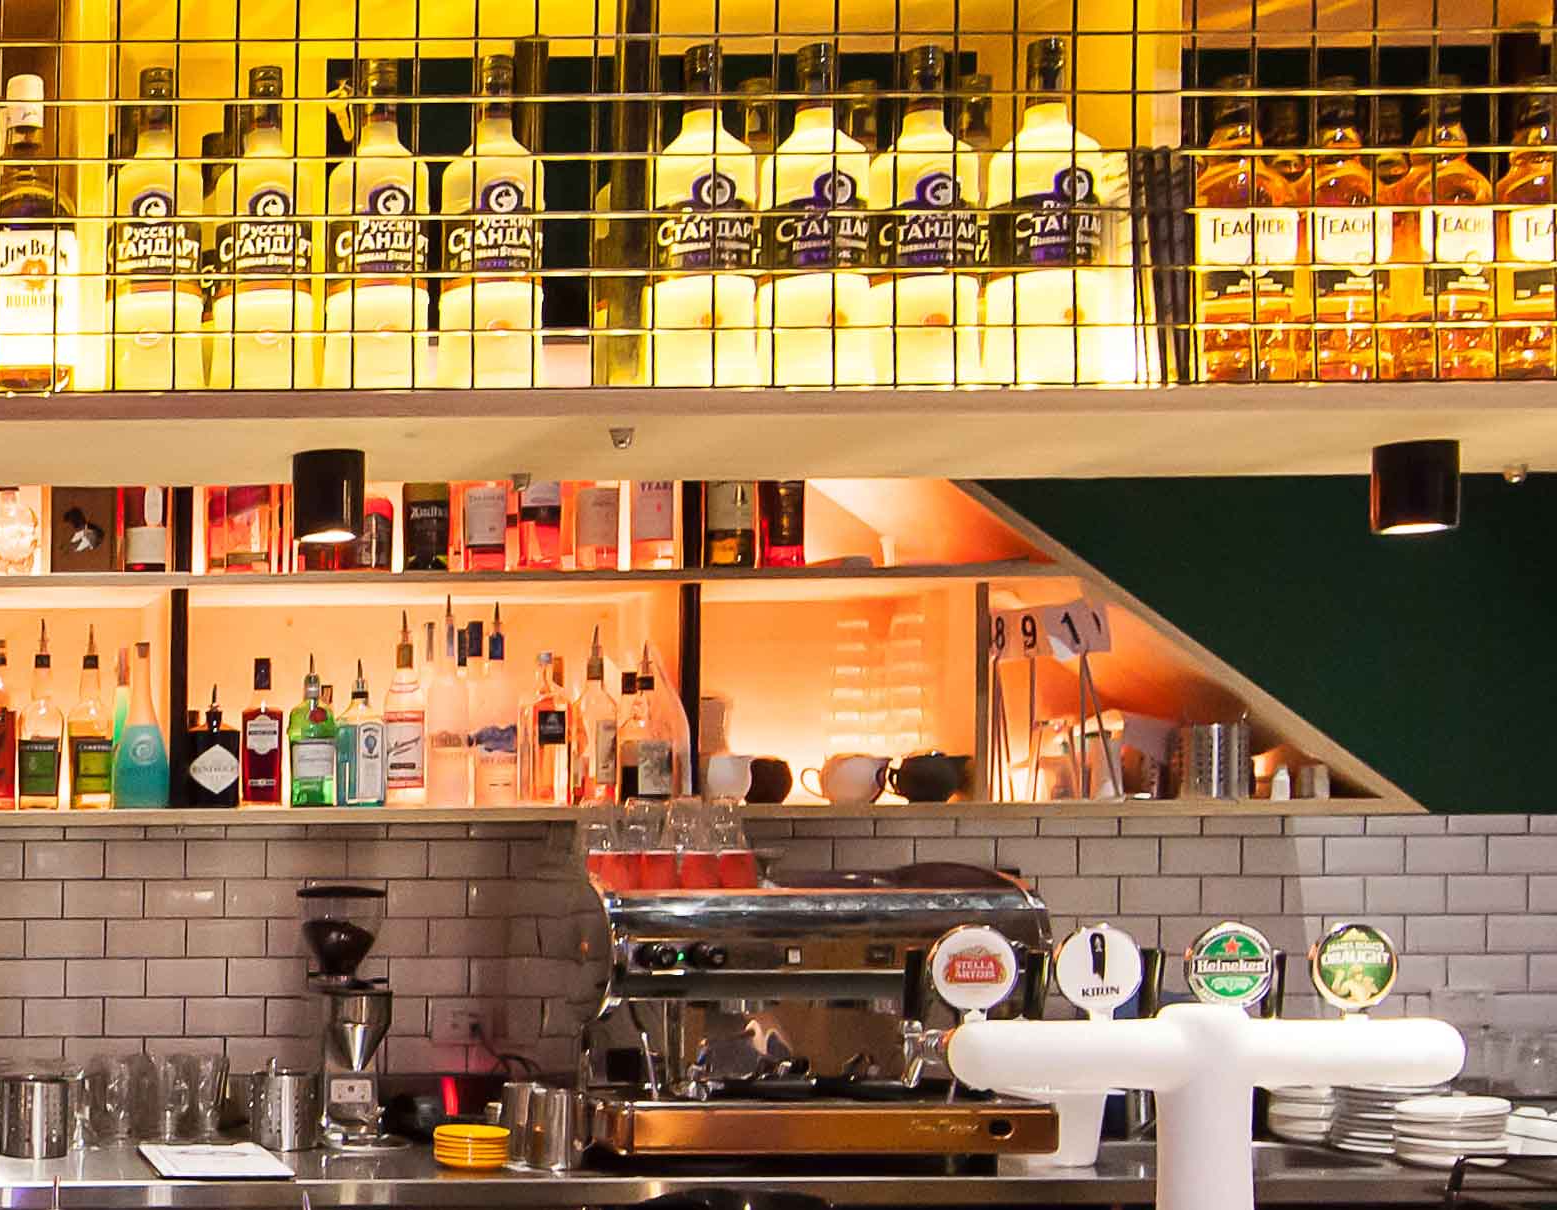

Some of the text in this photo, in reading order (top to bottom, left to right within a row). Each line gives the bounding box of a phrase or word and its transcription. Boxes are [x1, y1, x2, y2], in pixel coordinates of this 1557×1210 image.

[995, 616, 1005, 650] 8
[1020, 615, 1036, 649] 9
[954, 960, 995, 970] STELLA
[1197, 959, 1267, 973] Heineken
